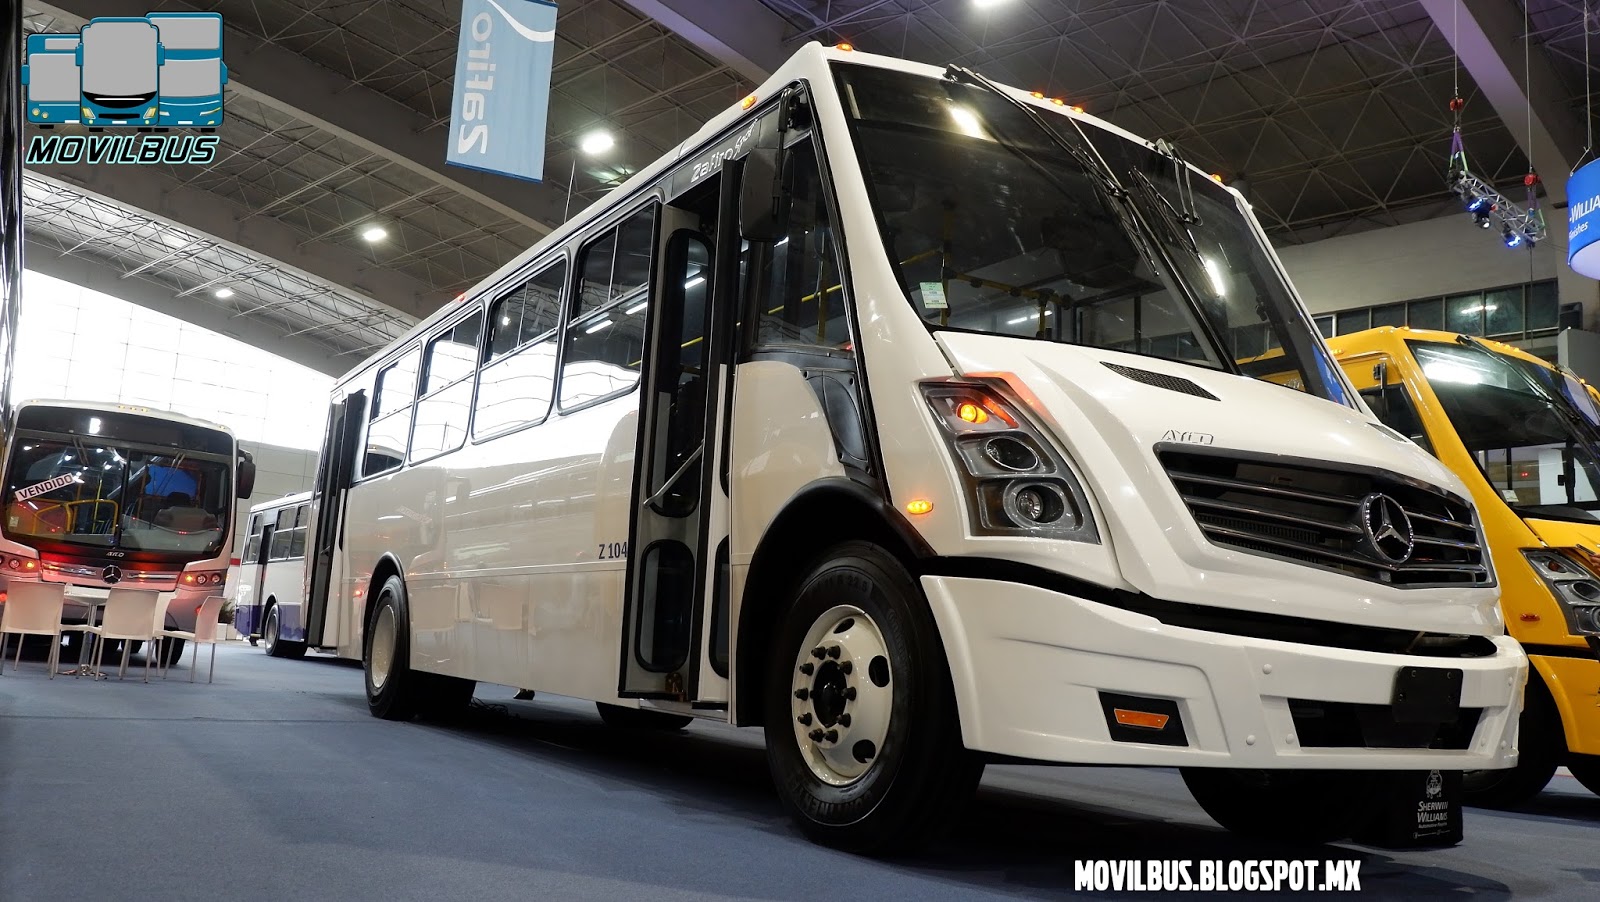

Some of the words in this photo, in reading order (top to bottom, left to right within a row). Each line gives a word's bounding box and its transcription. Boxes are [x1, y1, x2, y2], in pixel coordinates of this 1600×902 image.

[691, 148, 734, 183] Zafiro
[19, 474, 73, 499] VENDIDO
[598, 543, 605, 559] Z
[1418, 801, 1449, 812] SHERWIN
[1417, 812, 1448, 823] WILLIAMS
